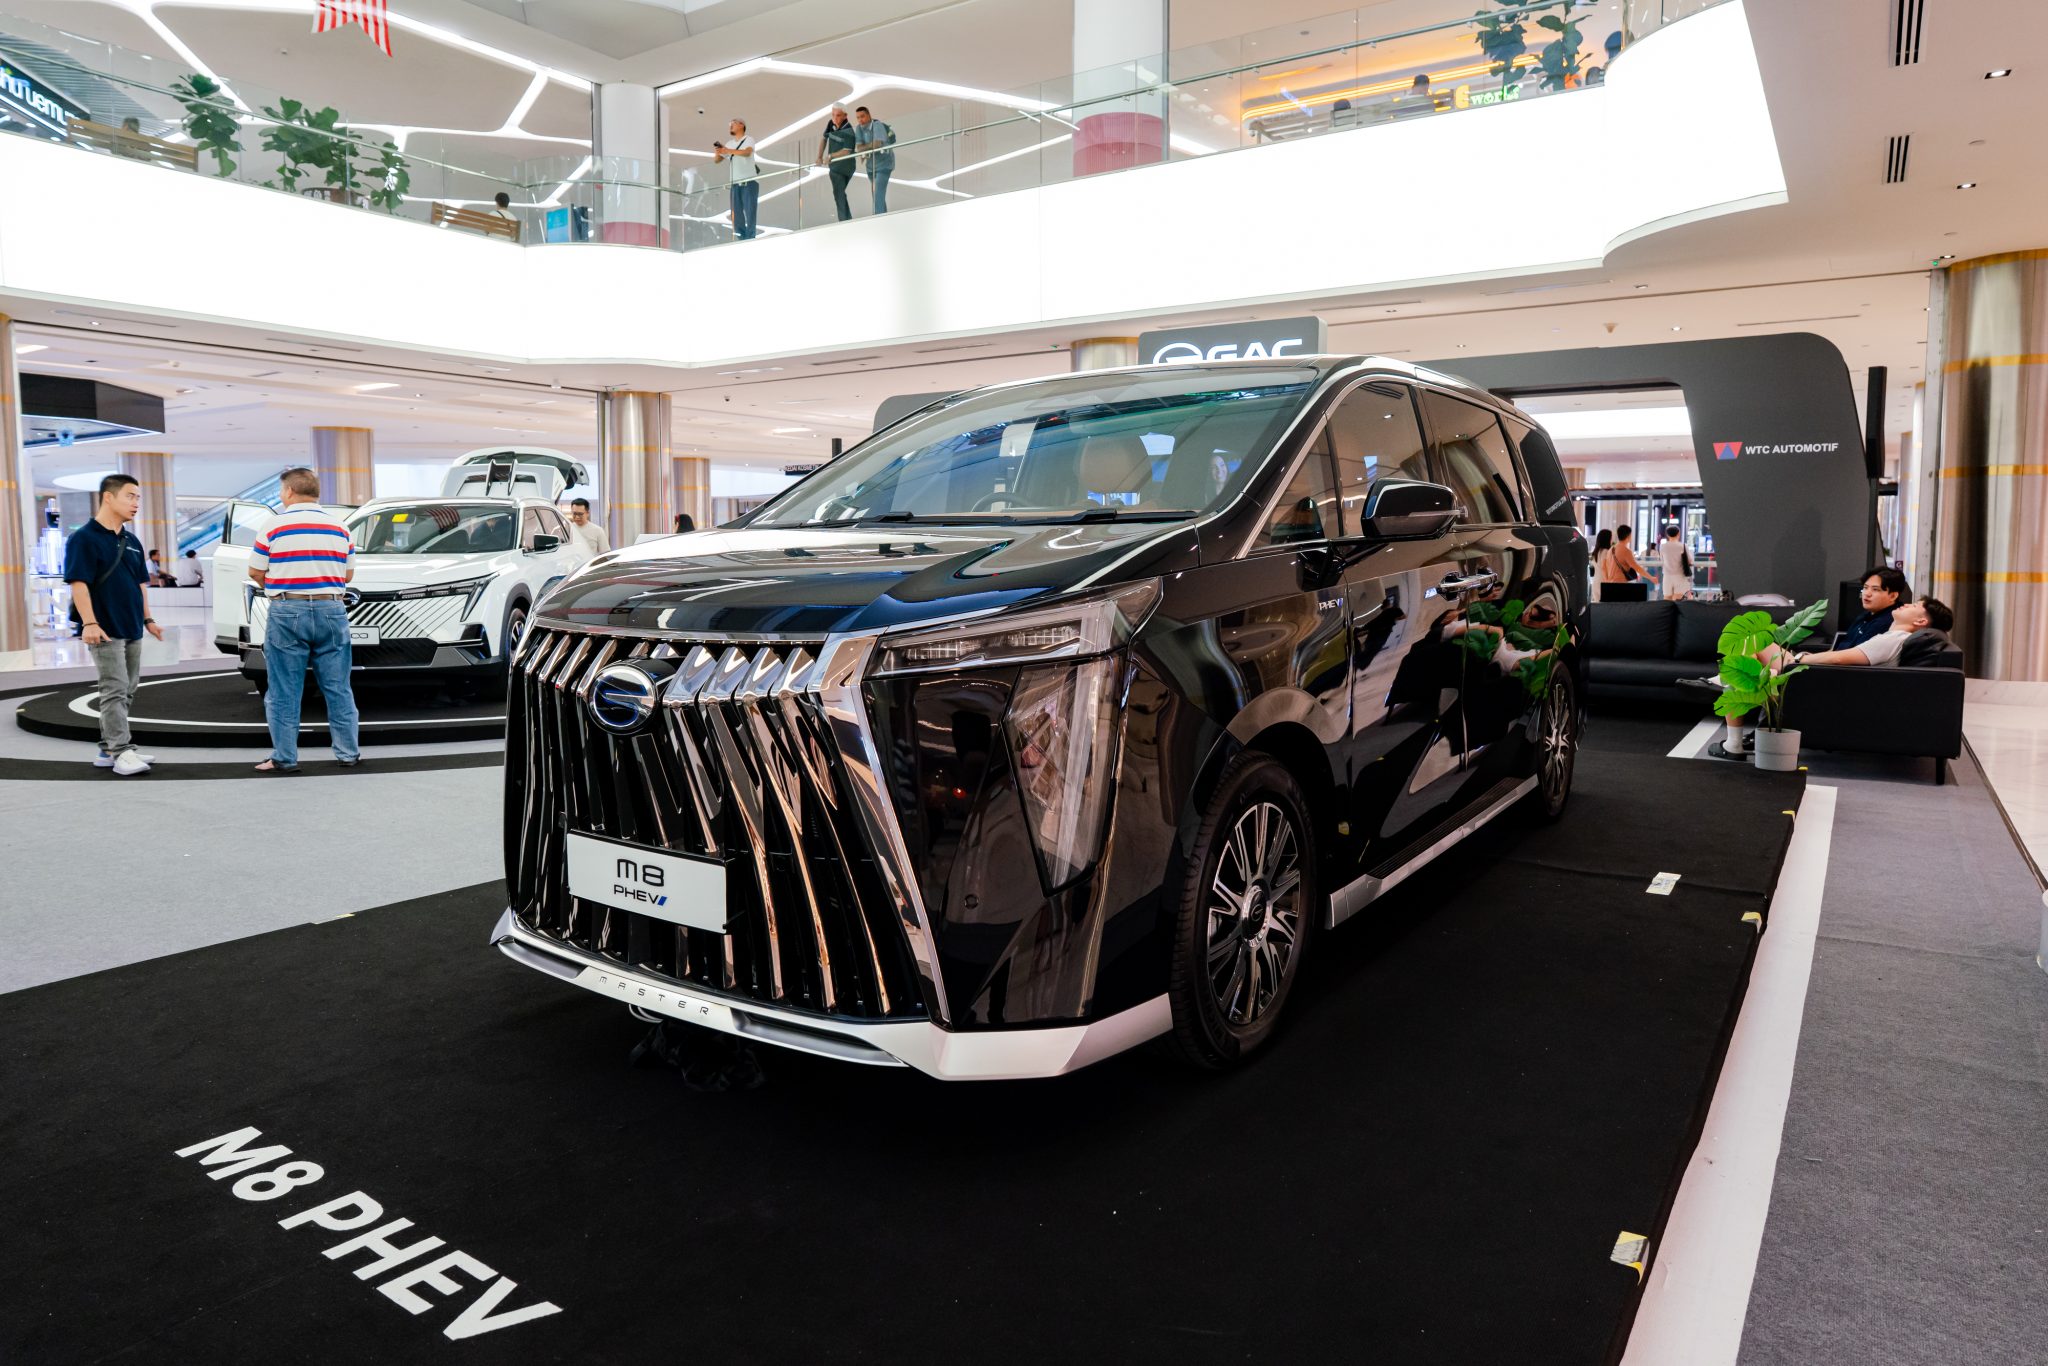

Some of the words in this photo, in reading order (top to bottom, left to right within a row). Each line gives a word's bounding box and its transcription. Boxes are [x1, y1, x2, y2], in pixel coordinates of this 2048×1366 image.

[1206, 338, 1302, 362] GAC
[1745, 445, 1770, 455] WTC
[1772, 443, 1839, 454] AUTOMOTIF
[614, 884, 660, 904] PHEV
[600, 976, 709, 1015] MASTER
[174, 1126, 324, 1200] M8
[278, 1190, 563, 1340] PHEV
